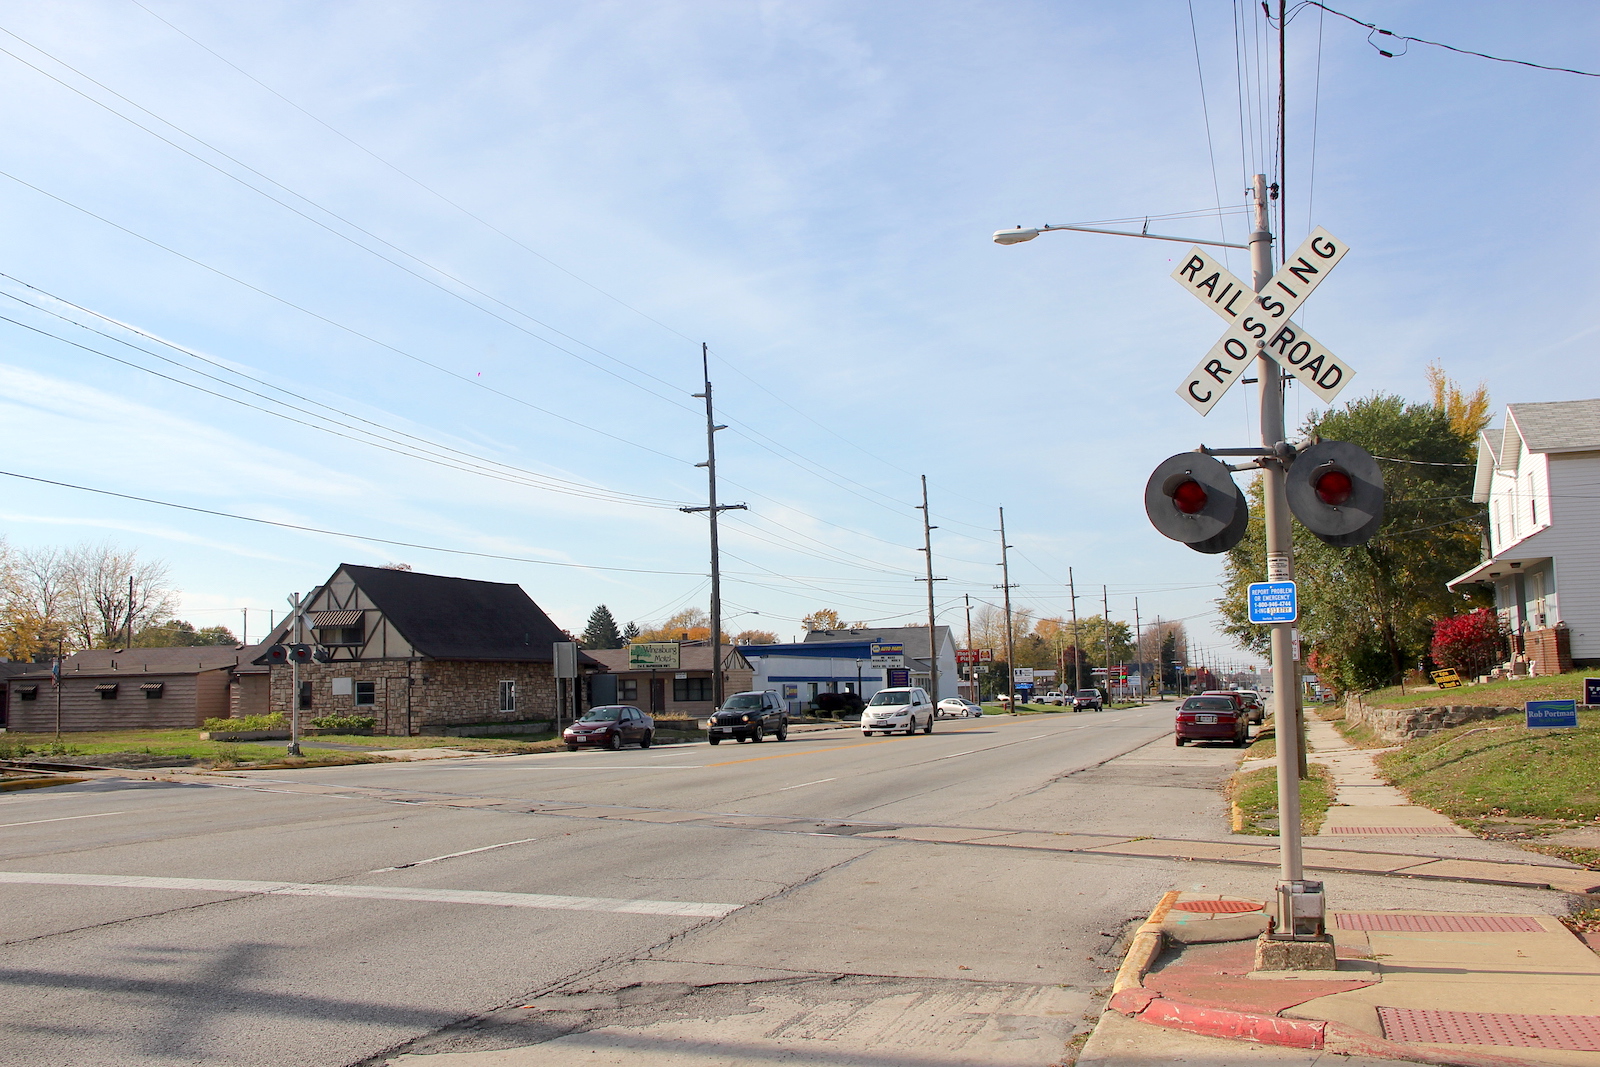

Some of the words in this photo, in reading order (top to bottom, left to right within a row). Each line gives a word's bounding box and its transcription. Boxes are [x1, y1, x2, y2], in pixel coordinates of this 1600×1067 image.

[1179, 254, 1242, 318] RAIL
[1270, 326, 1343, 390] ROAD
[1188, 236, 1336, 403] CROSSING
[641, 644, 677, 655] Winesburg
[1528, 710, 1543, 718] Rob
[1544, 710, 1574, 718] Portman
